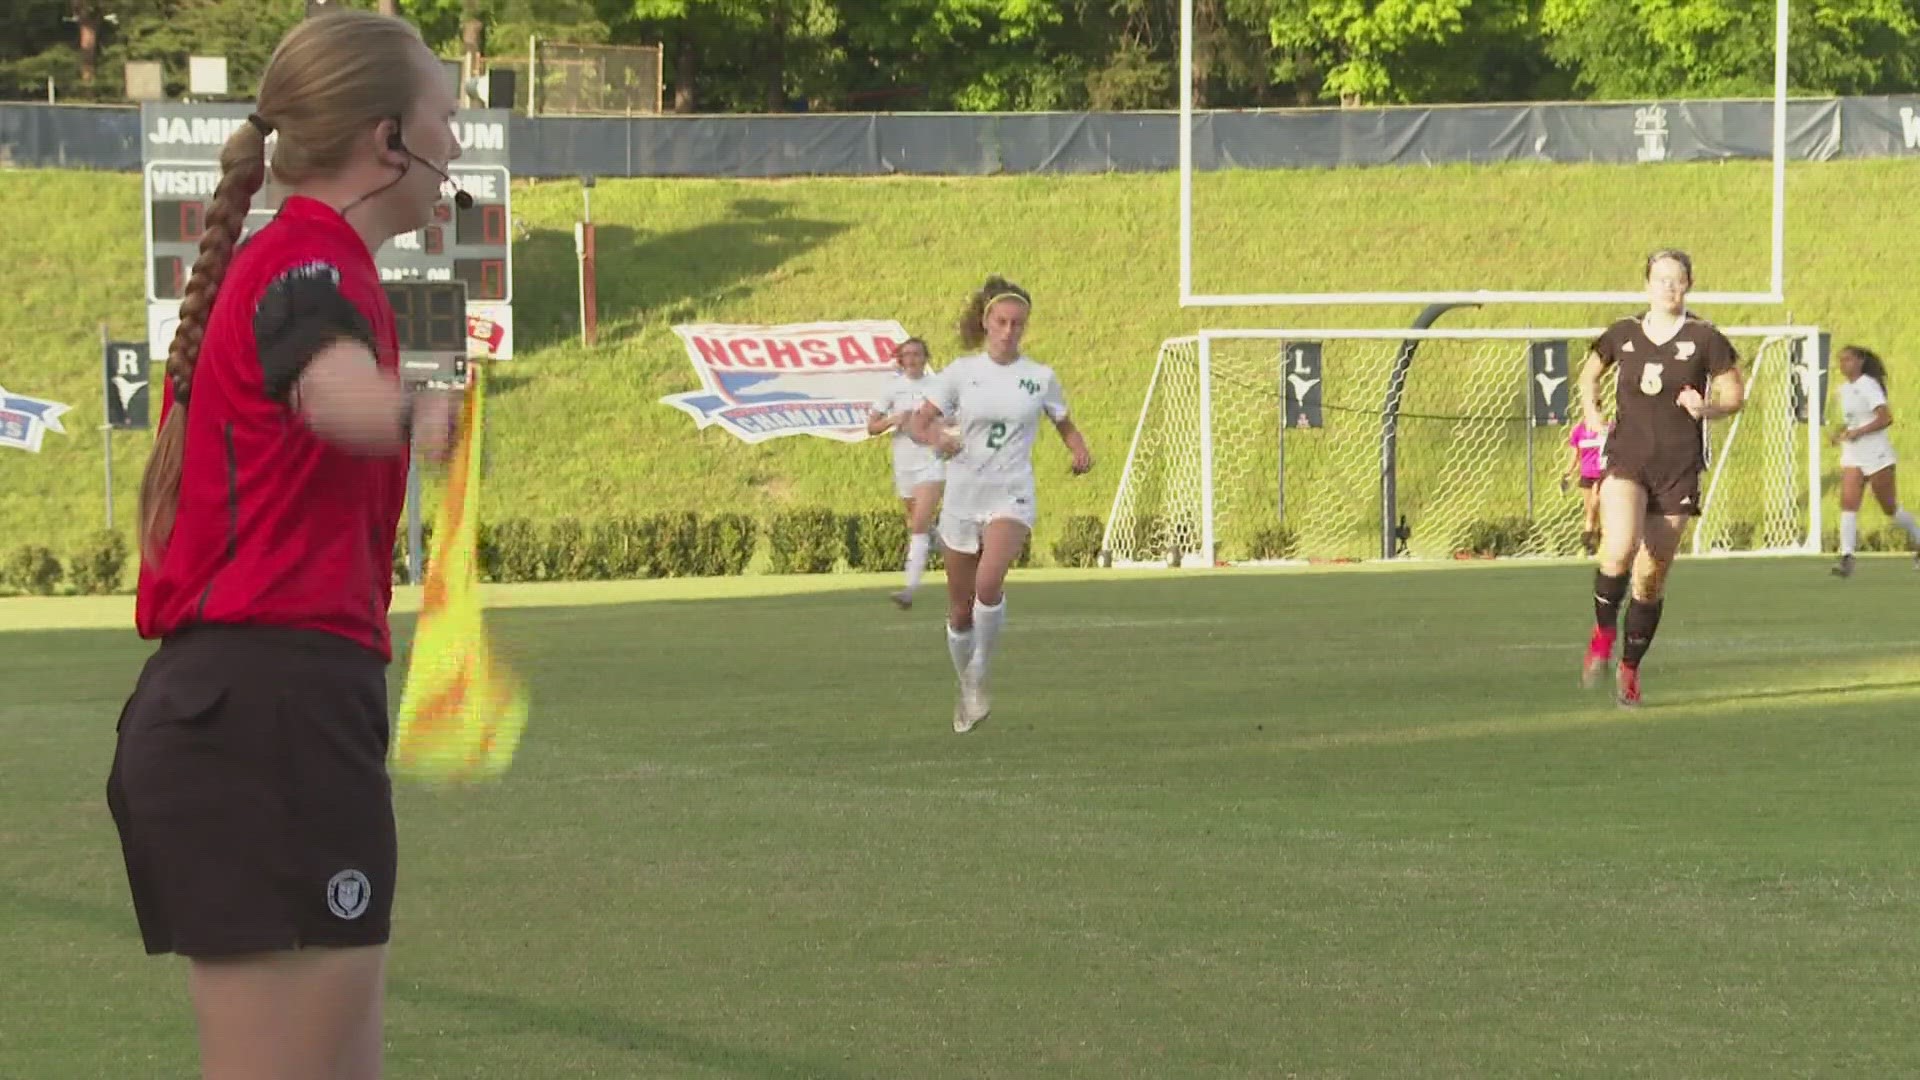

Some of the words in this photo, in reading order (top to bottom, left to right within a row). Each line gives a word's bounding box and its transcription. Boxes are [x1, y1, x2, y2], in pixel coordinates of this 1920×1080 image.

[117, 349, 139, 375] R
[1294, 349, 1312, 374] L
[986, 422, 1006, 448] 2
